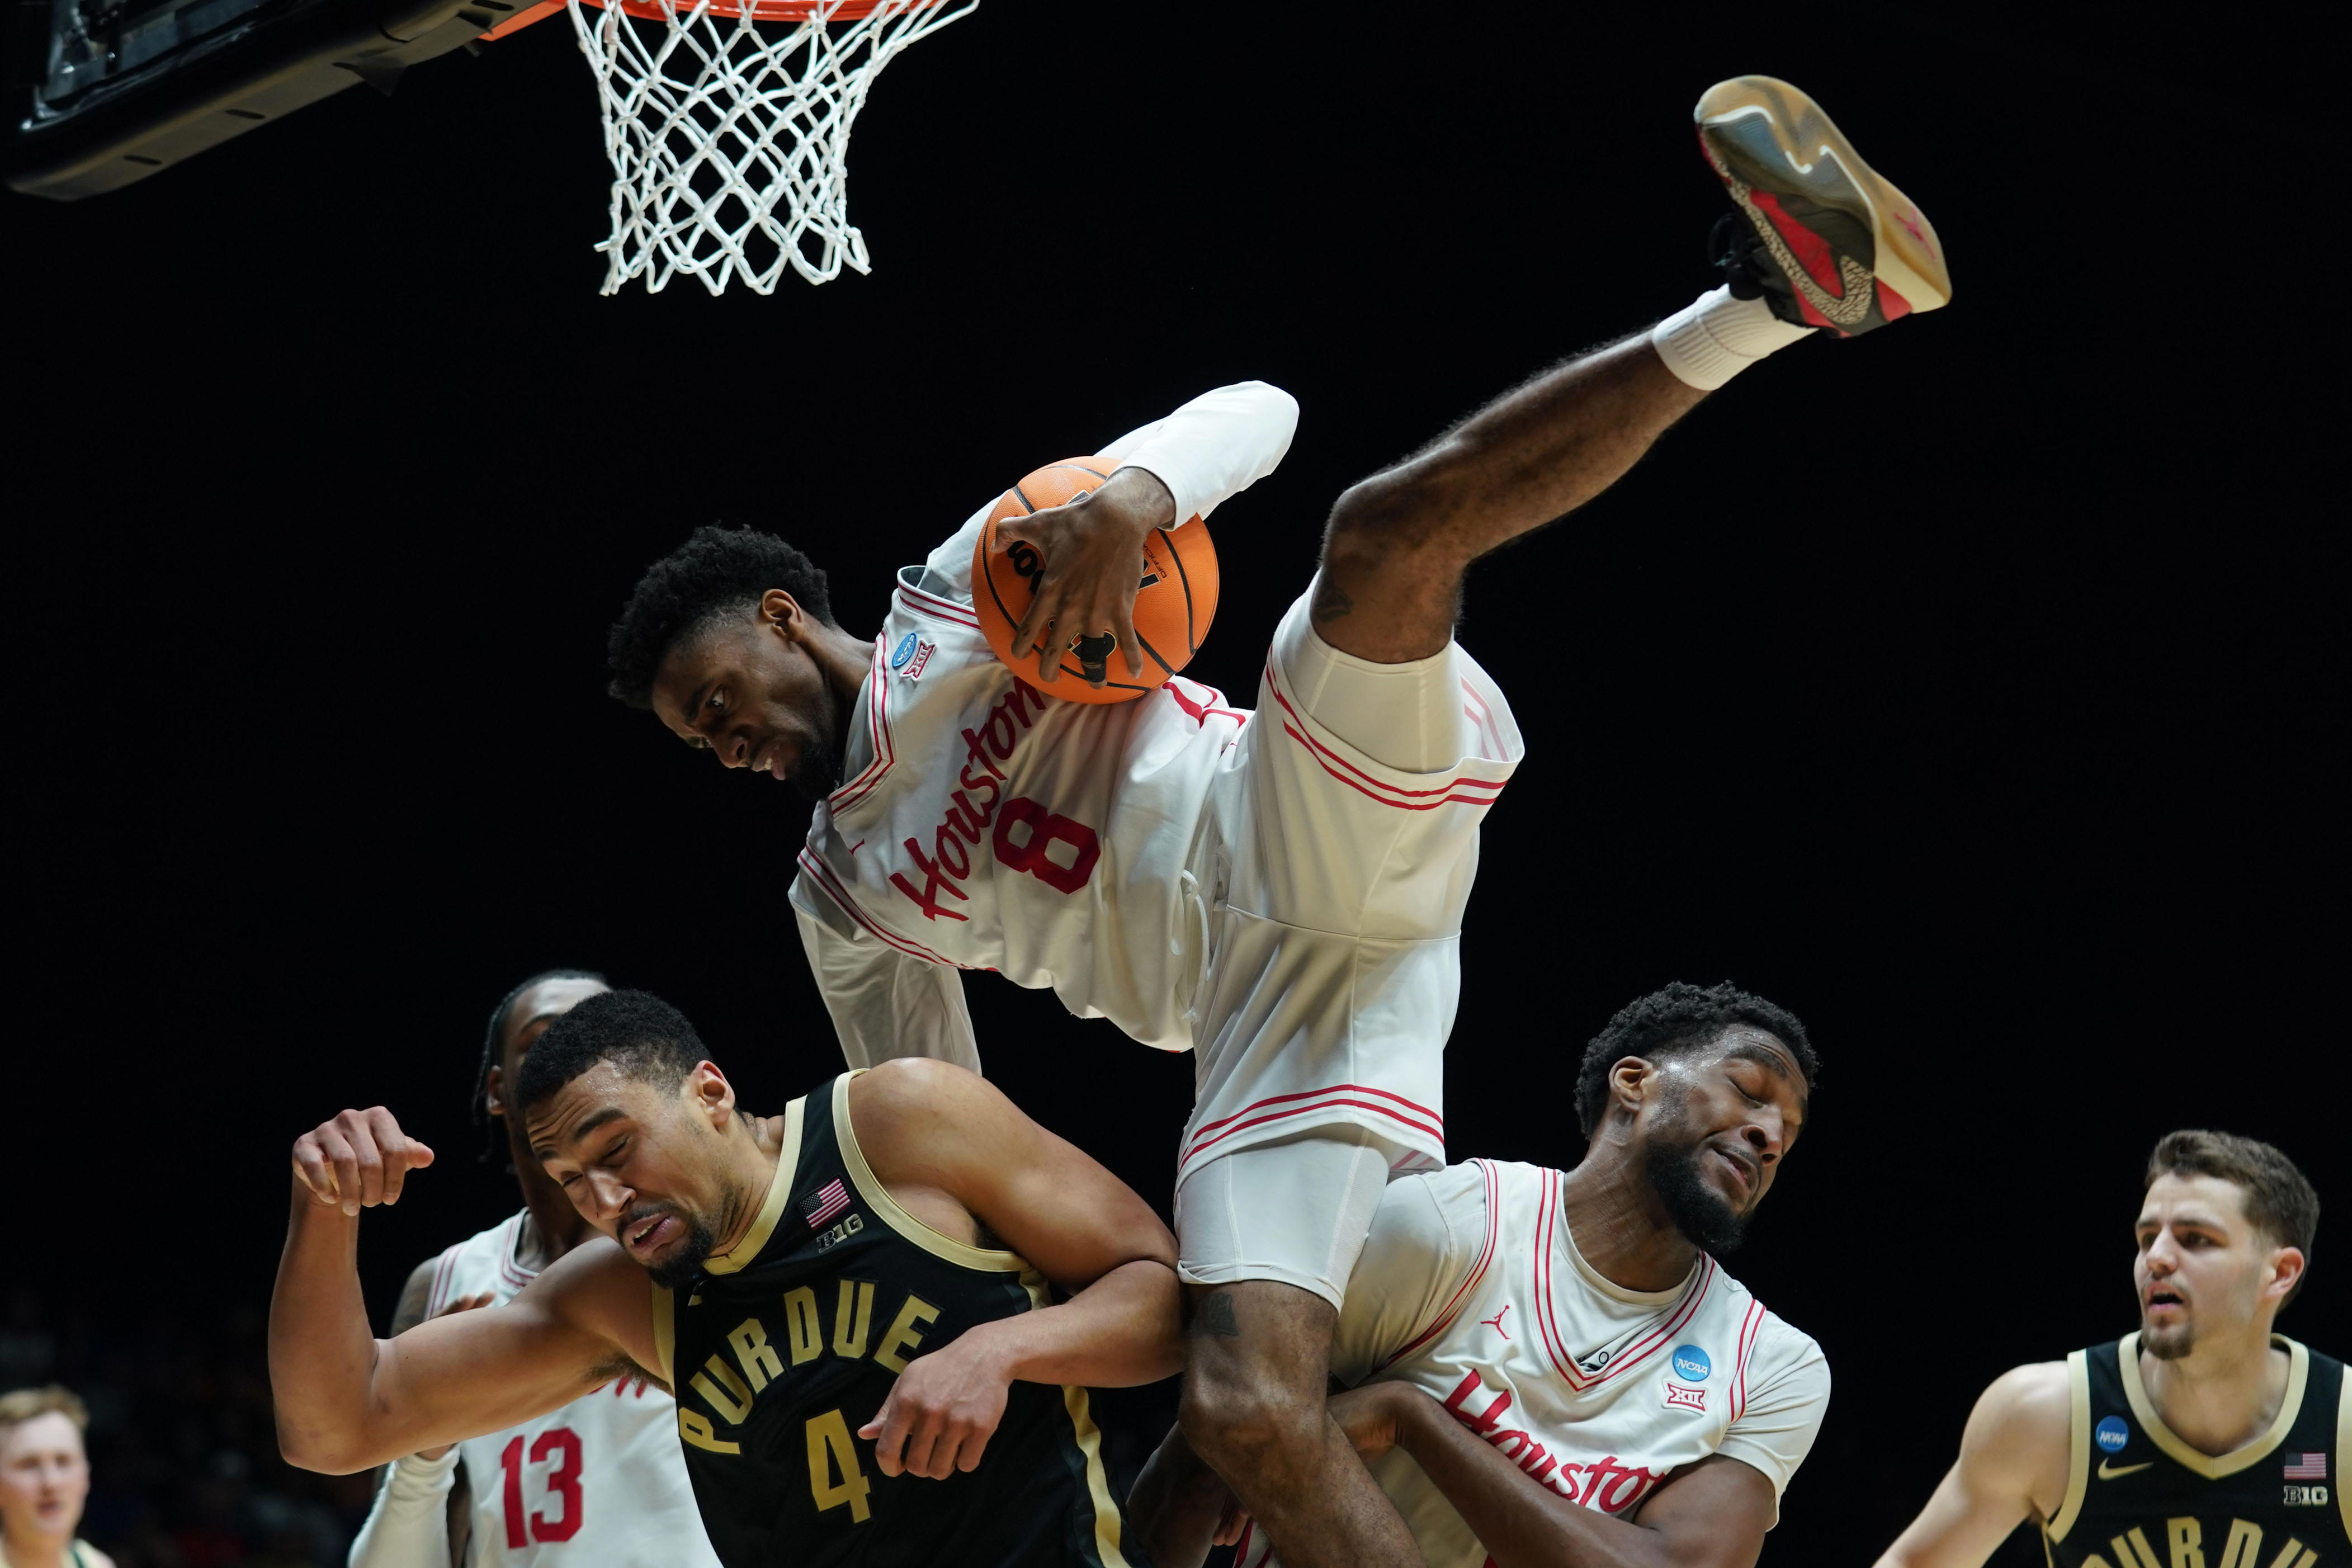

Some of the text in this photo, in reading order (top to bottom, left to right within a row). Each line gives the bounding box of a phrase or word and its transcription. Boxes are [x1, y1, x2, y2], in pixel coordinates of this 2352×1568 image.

[890, 676, 1046, 922] Houston
[993, 796, 1101, 894] 8
[679, 1278, 942, 1454] PURDUE
[1677, 1358, 1708, 1375] NCAA
[502, 1427, 583, 1548] 13
[805, 1408, 872, 1524] 4
[1443, 1368, 1666, 1513] Housto
[2099, 1430, 2126, 1446] NCAA
